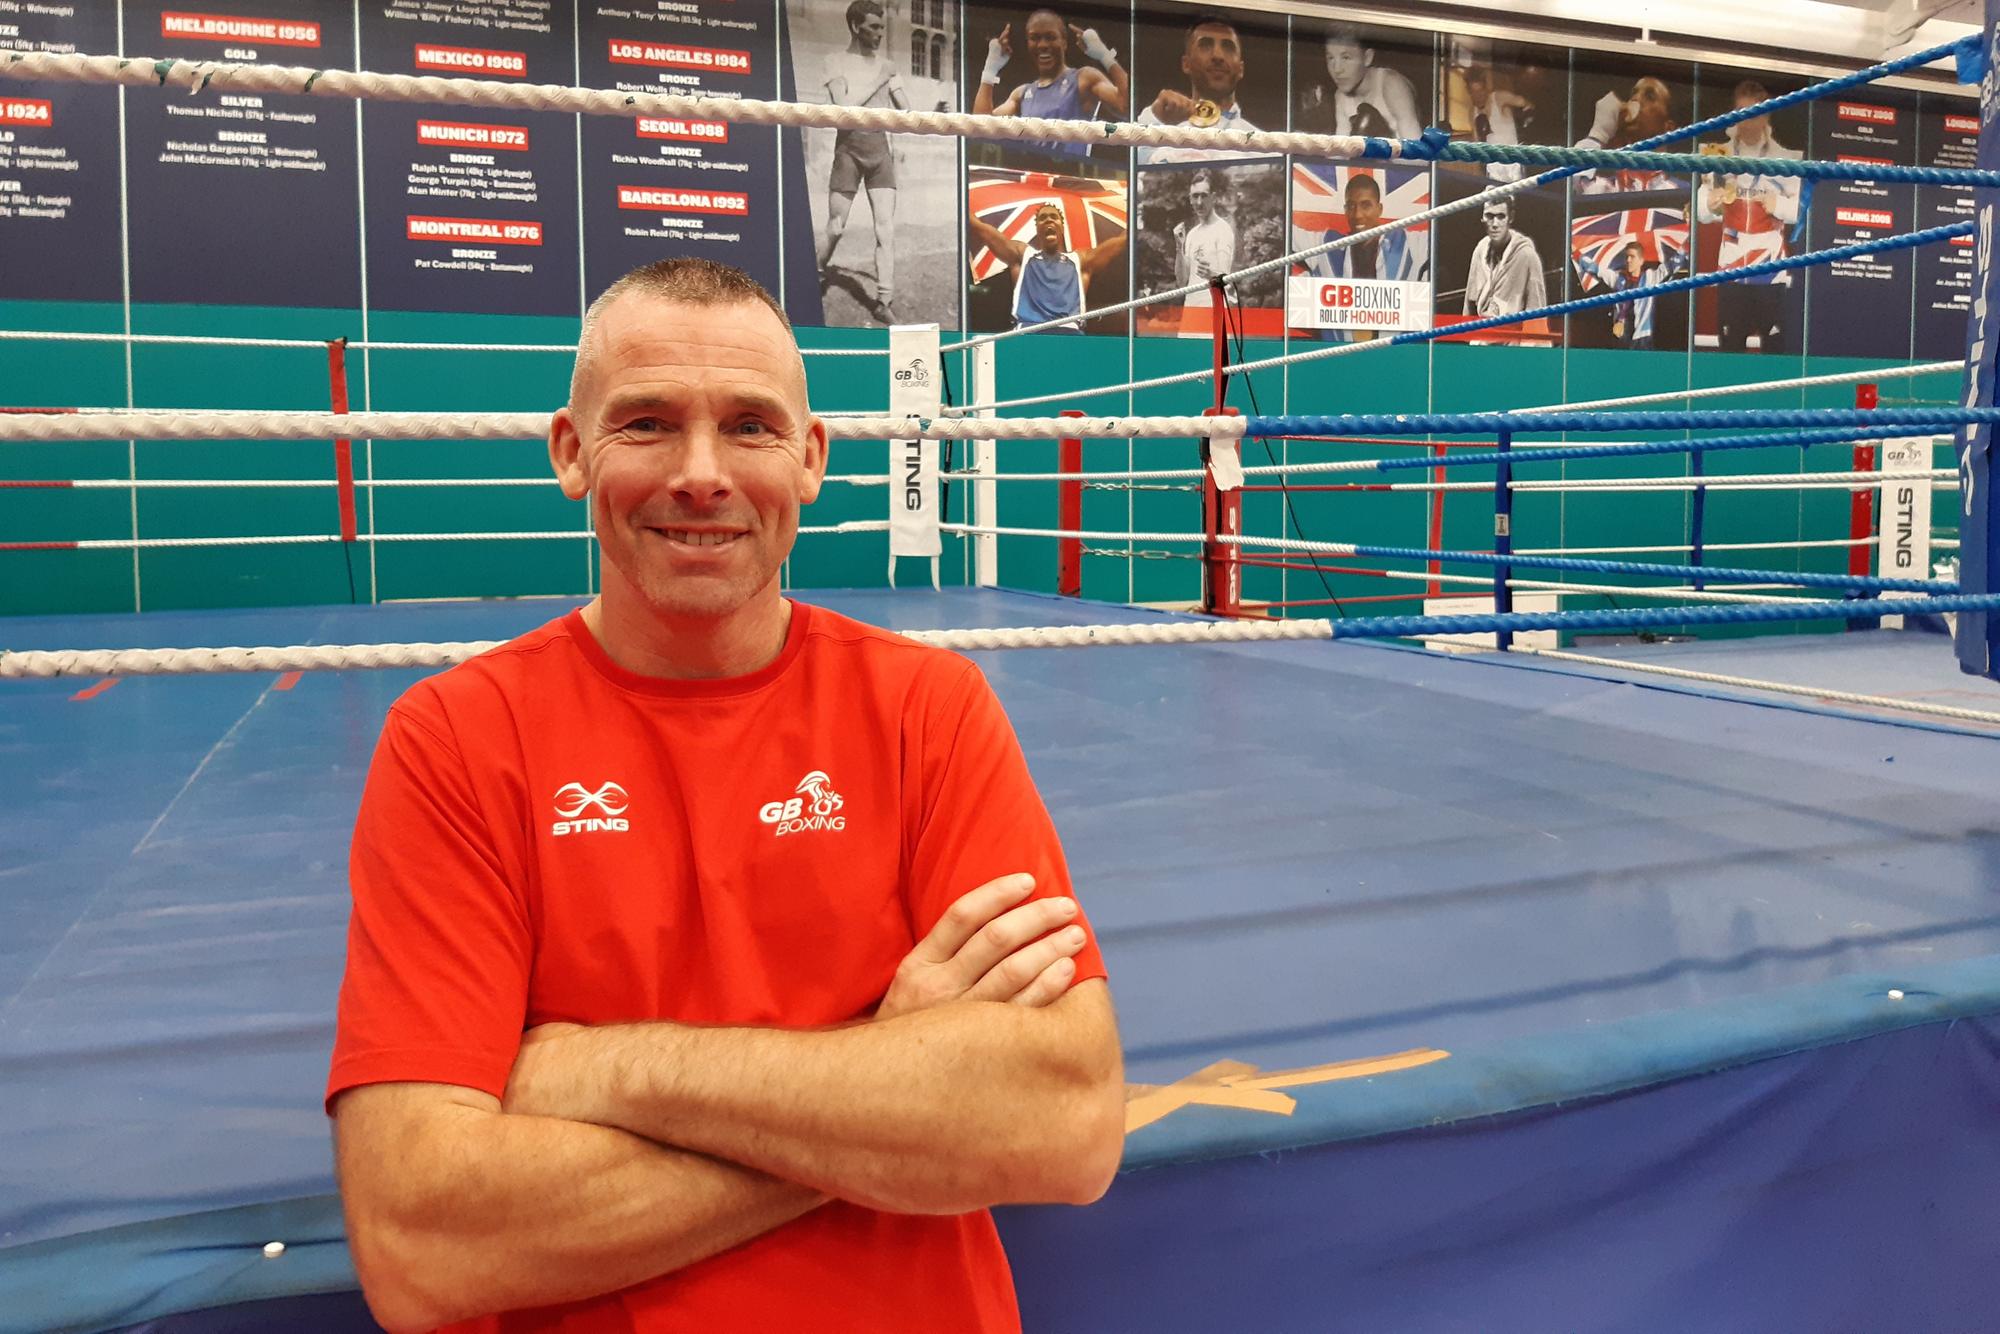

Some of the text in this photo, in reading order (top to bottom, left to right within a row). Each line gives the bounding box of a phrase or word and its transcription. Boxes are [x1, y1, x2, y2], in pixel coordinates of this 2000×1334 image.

[456, 5, 480, 14] Lloyd
[657, 1, 699, 13] BRONZE
[384, 9, 418, 20] William
[445, 14, 472, 24] Fisher
[597, 8, 631, 19] Anthony
[658, 13, 680, 23] Willis
[165, 16, 317, 41] MELBOURNE 1956
[224, 48, 257, 60] GOLD
[418, 49, 523, 70] MEXICO 1968
[611, 44, 748, 68] LOS ANGELES 1984
[659, 73, 700, 85] BRONZE
[616, 81, 644, 92] Robert
[645, 84, 668, 95] Wells
[220, 96, 263, 108] SILVER
[6, 103, 49, 120] 1924
[166, 104, 204, 116] Thomas
[639, 119, 725, 137] SEOUL 1988
[218, 130, 267, 143] BRONZE
[420, 125, 525, 145] MUNICH 1972
[166, 141, 208, 152] Nicholas
[209, 143, 249, 156] Gargano
[660, 145, 702, 157] BRONZE
[159, 152, 183, 163] John
[184, 153, 241, 166] McCormack
[449, 153, 495, 165] BRONZE
[611, 154, 638, 164] Richie
[638, 156, 676, 167] Woodhall
[411, 163, 437, 174] Ralph
[439, 165, 465, 175] Evans
[407, 174, 440, 185] George
[441, 176, 470, 187] Turpin
[407, 186, 428, 195] Alan
[429, 187, 459, 197] Minter
[620, 191, 746, 210] BARCELONA 1992
[662, 217, 704, 229] BRONZE
[410, 220, 539, 240] MONTREAL 1976
[624, 227, 649, 237] Robin
[649, 229, 668, 238] Reid
[451, 248, 497, 260] BRONZE
[415, 258, 431, 268] Pat
[431, 259, 467, 270] Cowdell
[1319, 309, 1400, 325] ROLL OF HONOUR
[894, 370, 912, 380] GB
[1896, 487, 1913, 568] STING
[759, 797, 803, 824] GB
[552, 818, 629, 836] STING
[775, 815, 846, 836] BOXING
